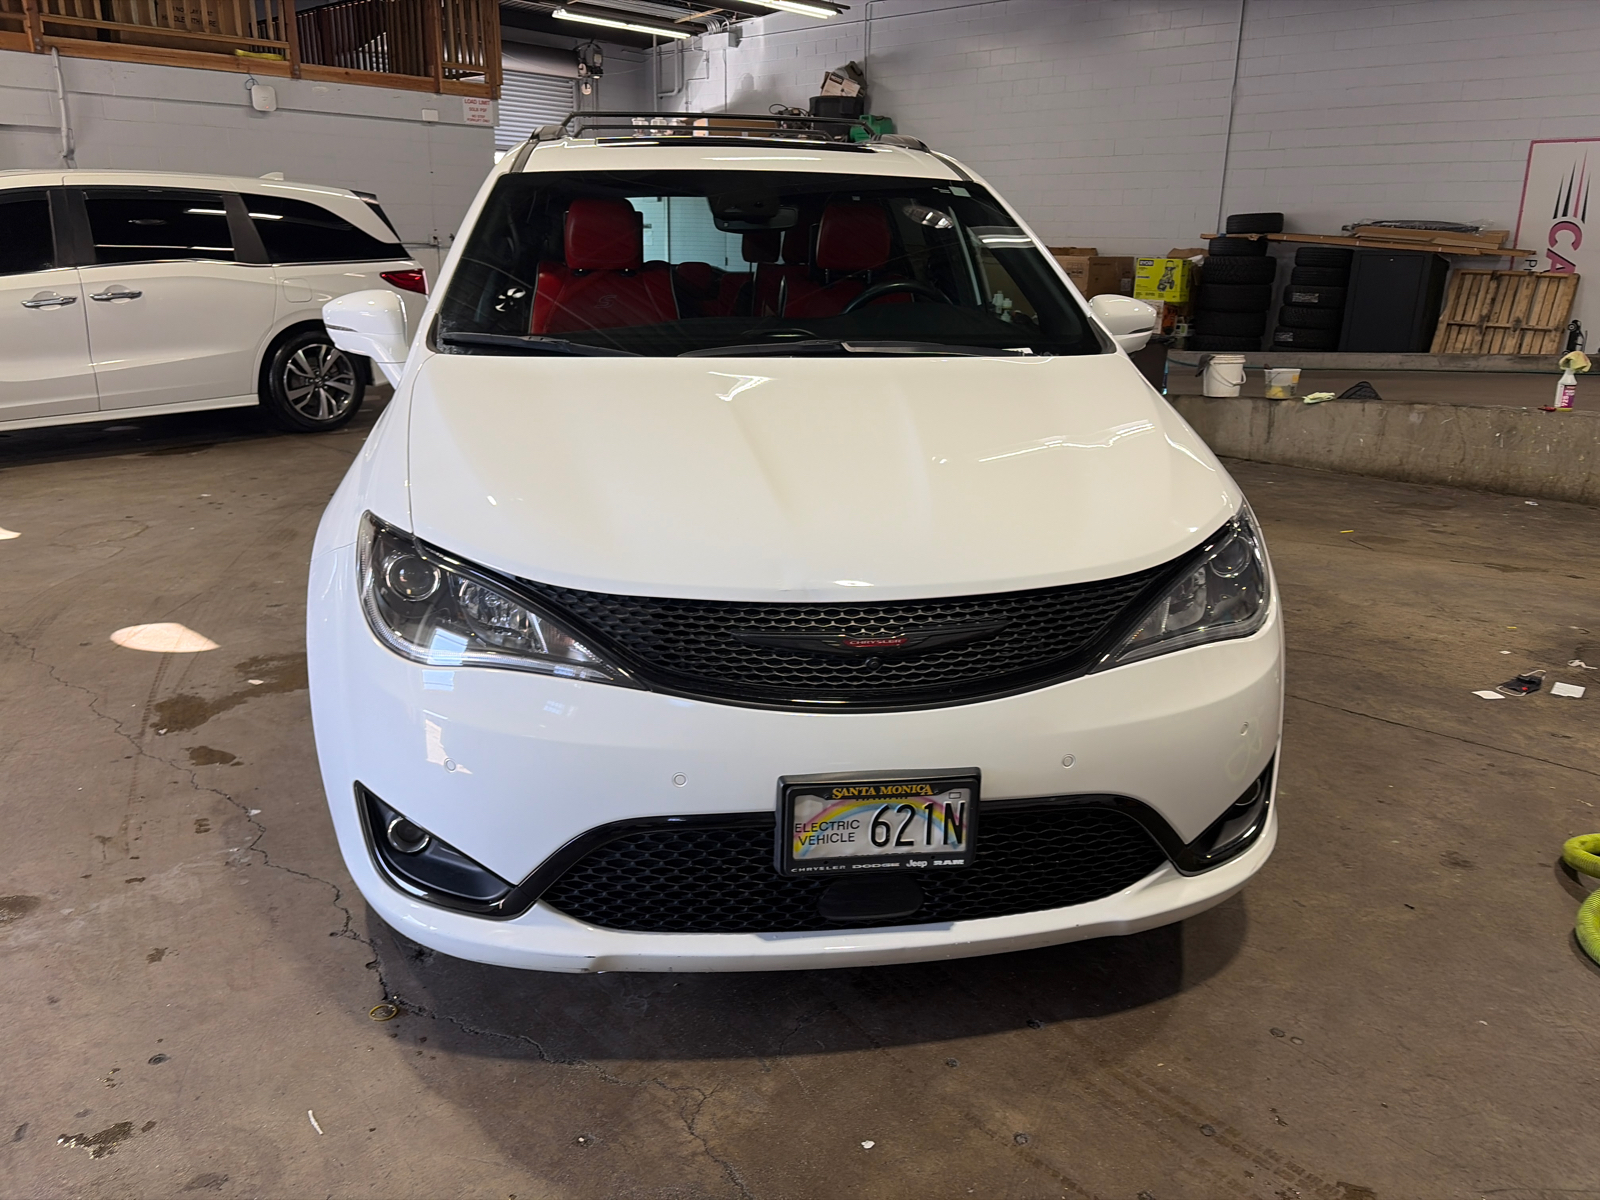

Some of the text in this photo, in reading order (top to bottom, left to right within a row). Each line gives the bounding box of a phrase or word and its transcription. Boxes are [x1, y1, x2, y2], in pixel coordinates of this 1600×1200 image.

[161, 13, 185, 23] HADLE
[832, 784, 933, 799] SANTA MONICA
[795, 819, 860, 833] ELECTRIC
[869, 800, 965, 848] 621N
[798, 832, 855, 846] VEHICLE
[790, 864, 846, 873] CHRYSLER
[905, 859, 928, 868] Jeep
